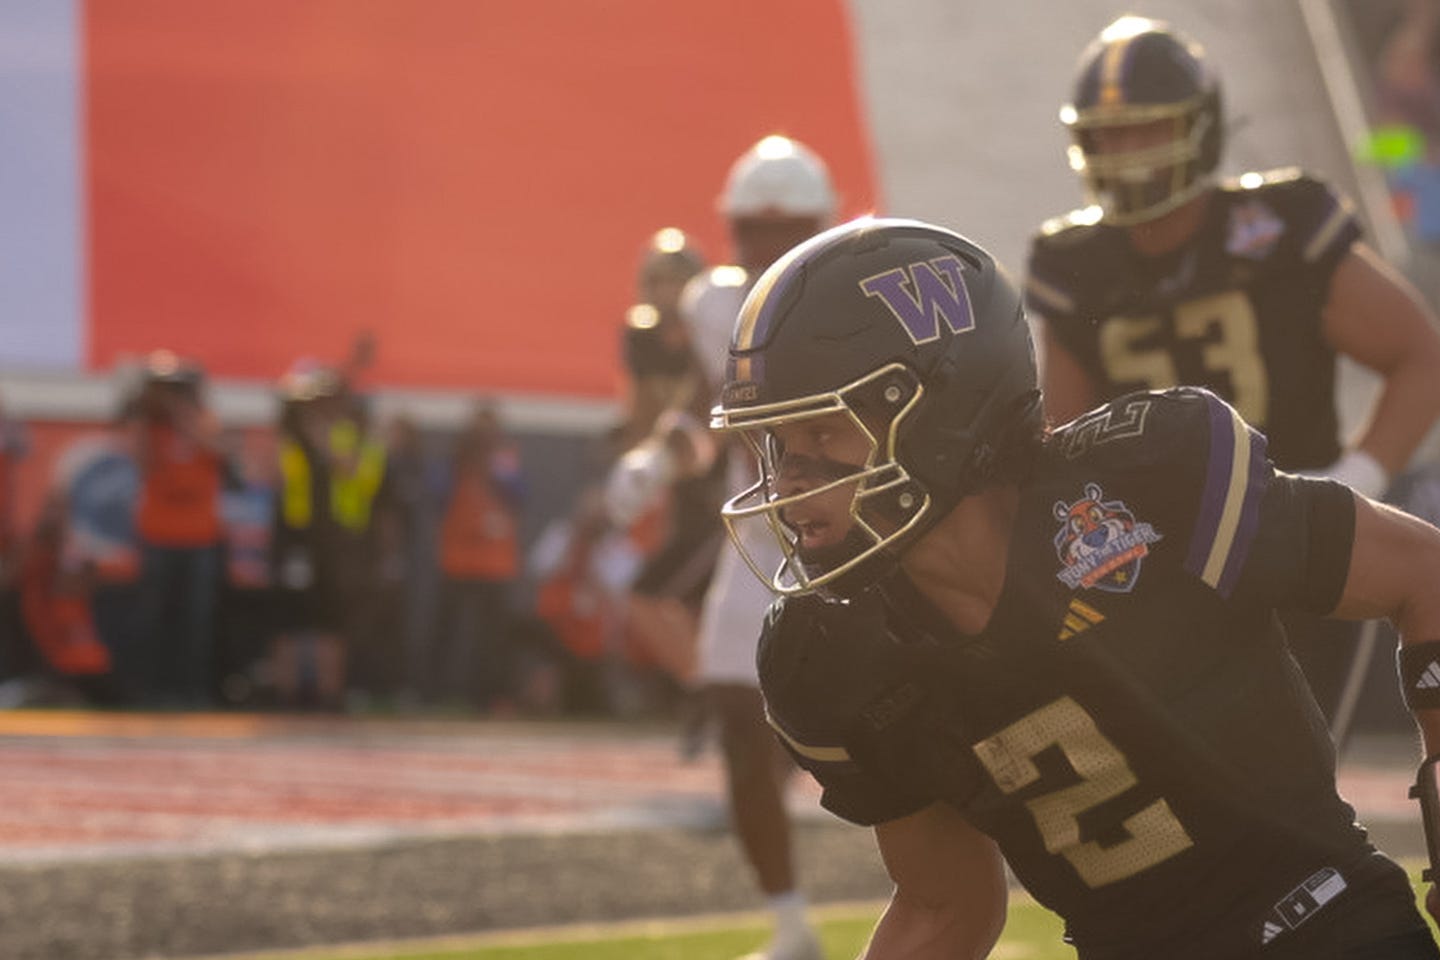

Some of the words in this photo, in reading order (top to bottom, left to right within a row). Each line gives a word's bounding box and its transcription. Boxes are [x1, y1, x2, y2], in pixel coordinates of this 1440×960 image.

[858, 255, 976, 346] W
[1100, 292, 1269, 428] 53
[972, 695, 1195, 889] 2
